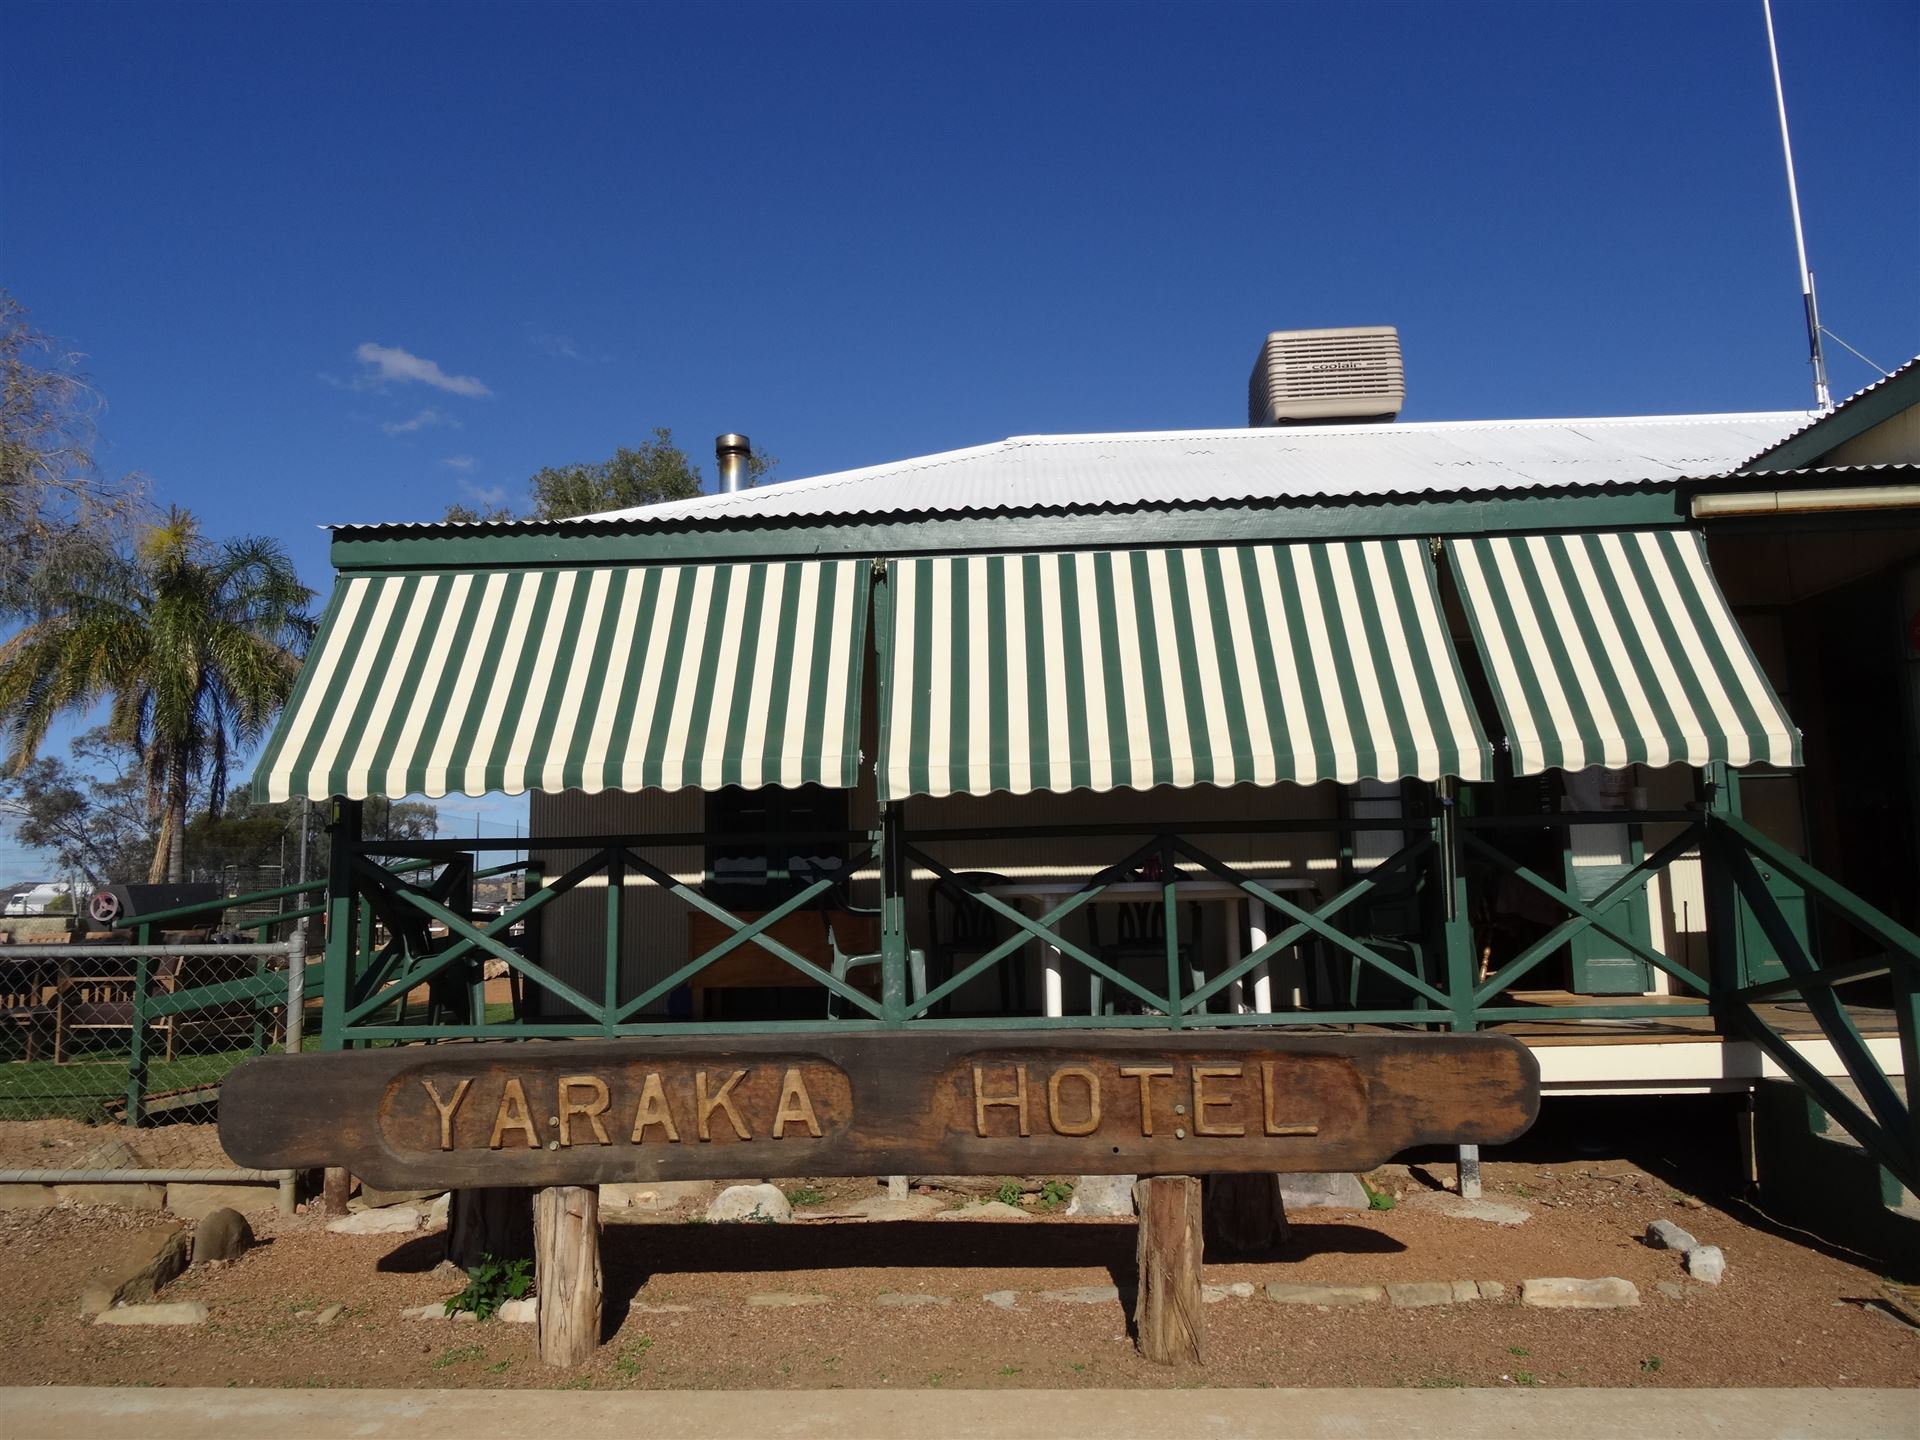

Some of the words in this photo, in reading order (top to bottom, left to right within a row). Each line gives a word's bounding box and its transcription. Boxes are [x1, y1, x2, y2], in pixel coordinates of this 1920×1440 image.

[1312, 362, 1362, 370] coolair
[420, 1068, 823, 1151] YARAKA
[973, 1061, 1319, 1137] HOTEL
